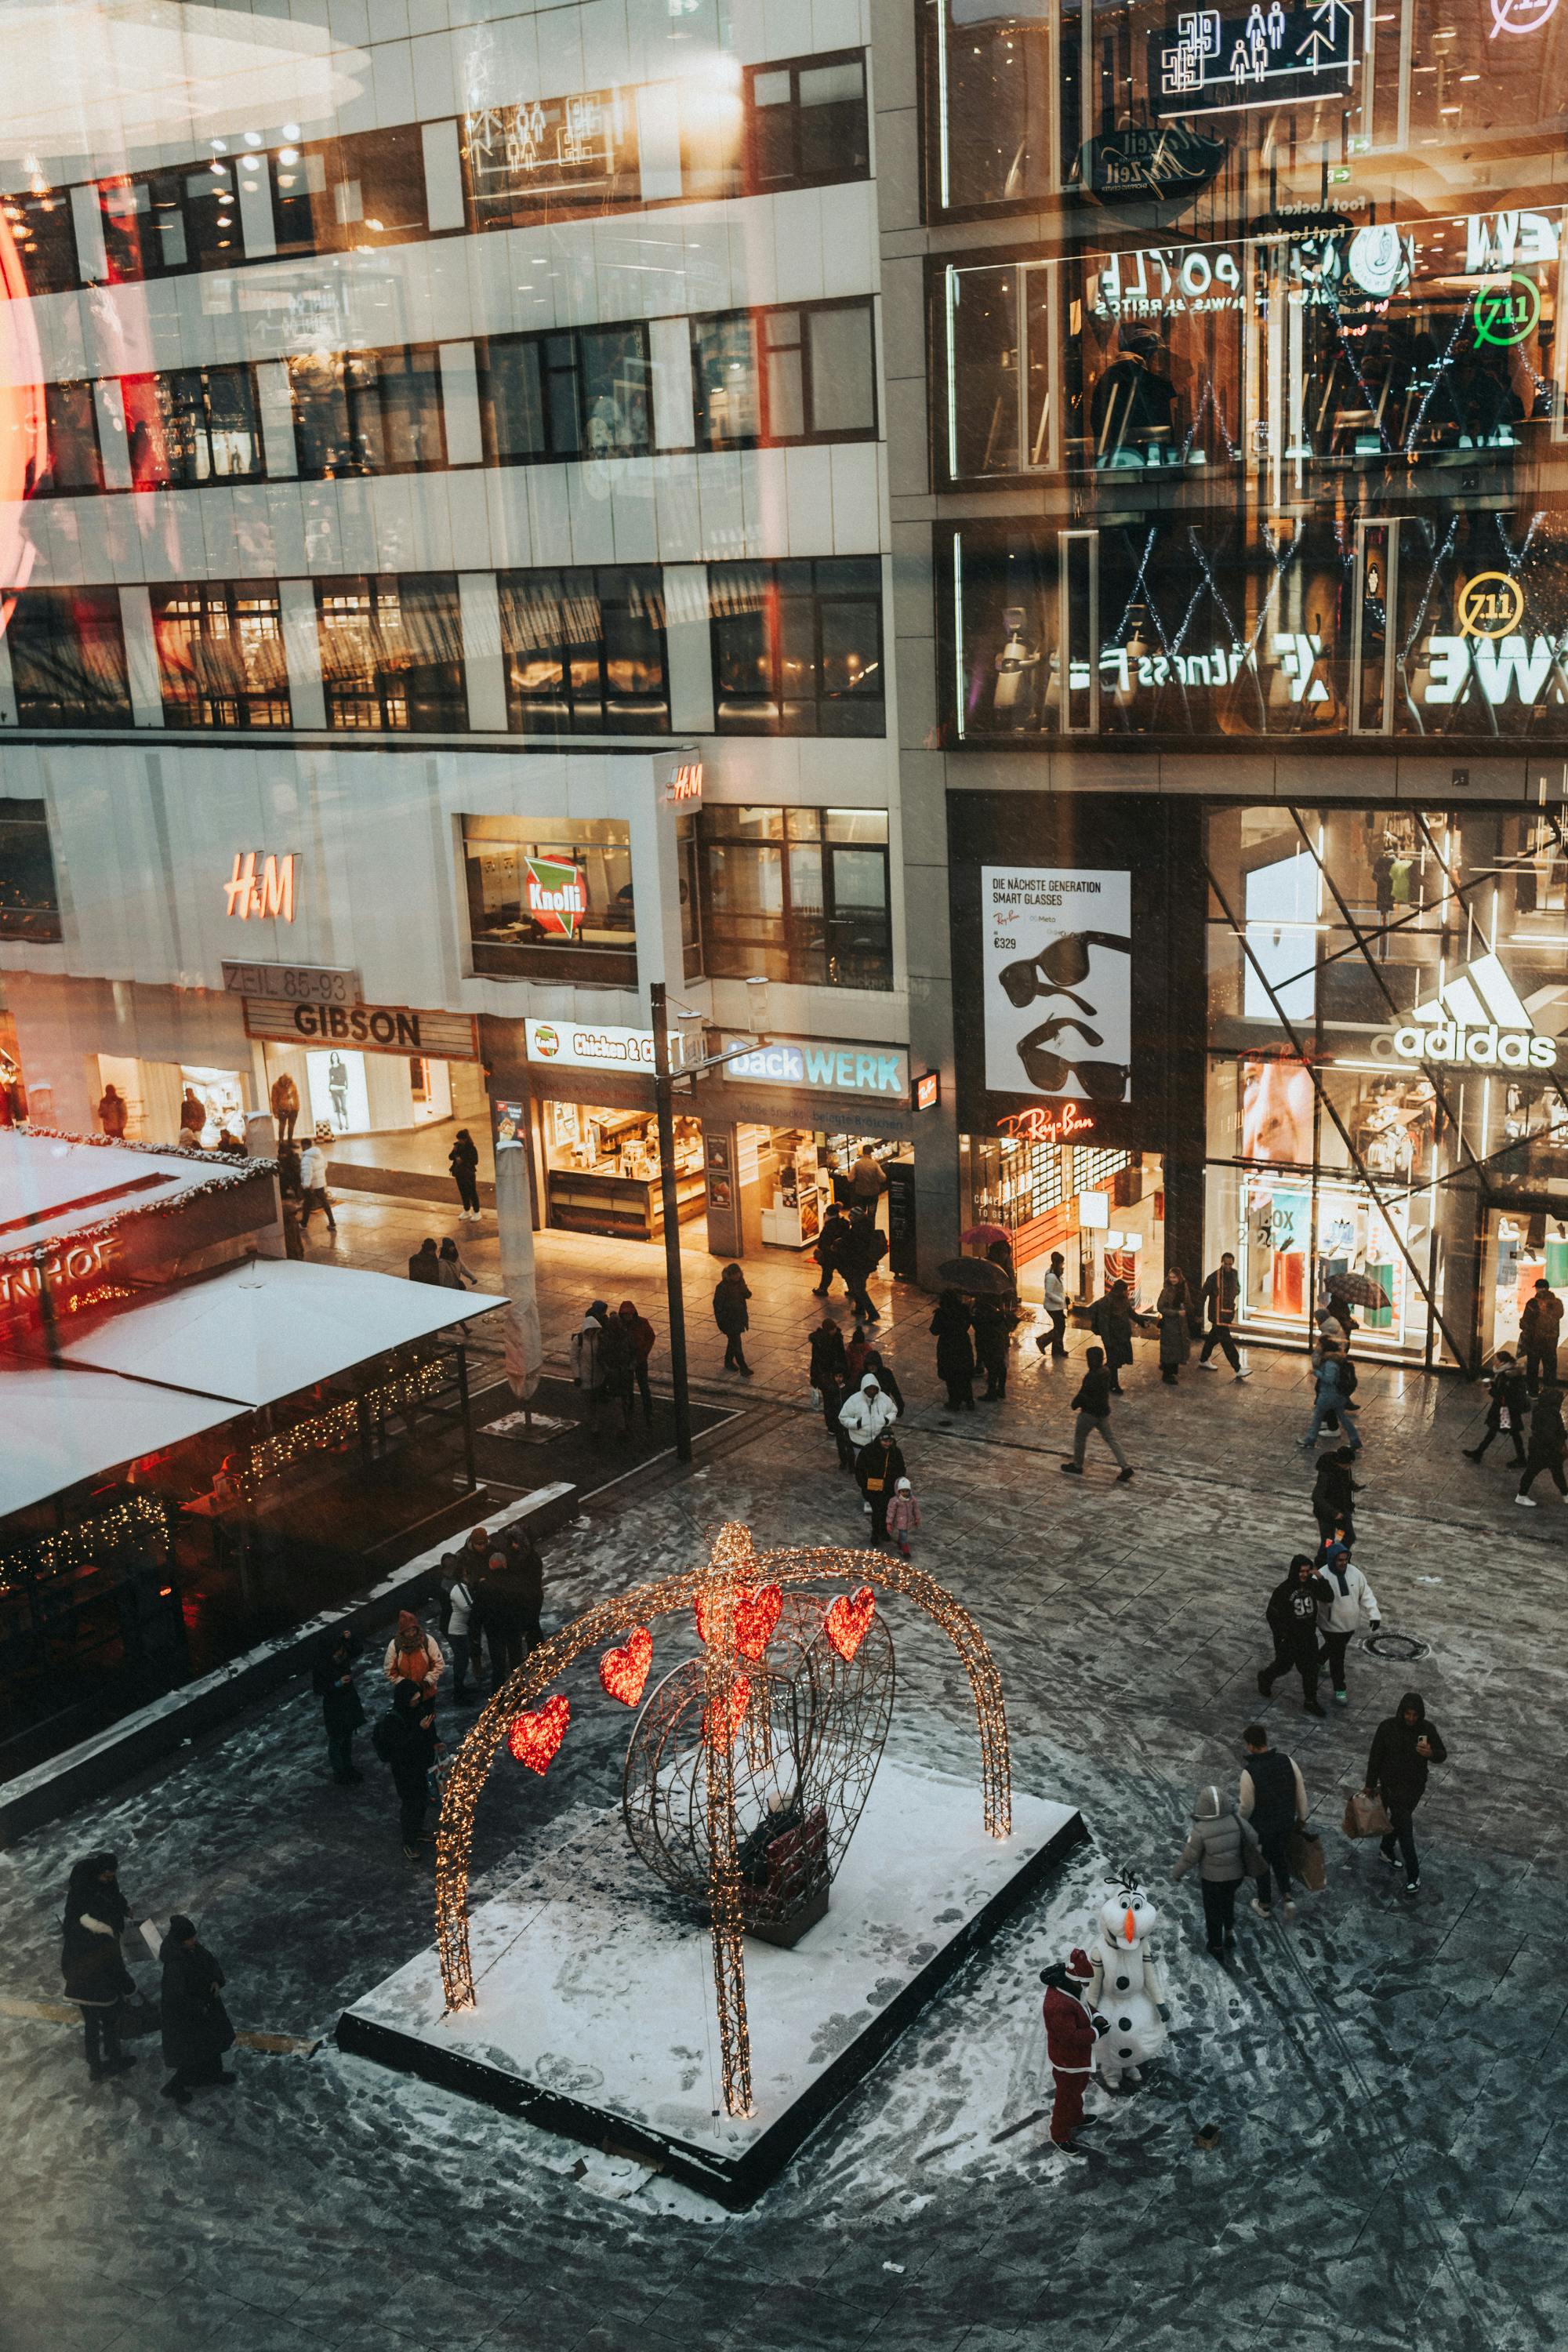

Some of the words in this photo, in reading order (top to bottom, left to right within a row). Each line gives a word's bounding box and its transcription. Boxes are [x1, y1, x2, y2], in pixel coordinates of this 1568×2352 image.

[674, 764, 703, 800] H&M
[223, 852, 294, 922] H&M
[993, 878, 1005, 890] DIE
[1007, 877, 1047, 891] NÄCHSTE
[1049, 880, 1102, 894] GENERATION
[993, 893, 1022, 904] SMART
[1024, 894, 1062, 906] GLASSES
[994, 938, 1017, 949] €329
[225, 965, 278, 995] ZEIL
[284, 971, 347, 1001] 85-93
[294, 1004, 421, 1054] GIBSON
[1394, 1021, 1556, 1068] adidas
[573, 1033, 627, 1060] Chicken
[628, 1038, 641, 1062] &
[1294, 1596, 1314, 1616] 99
